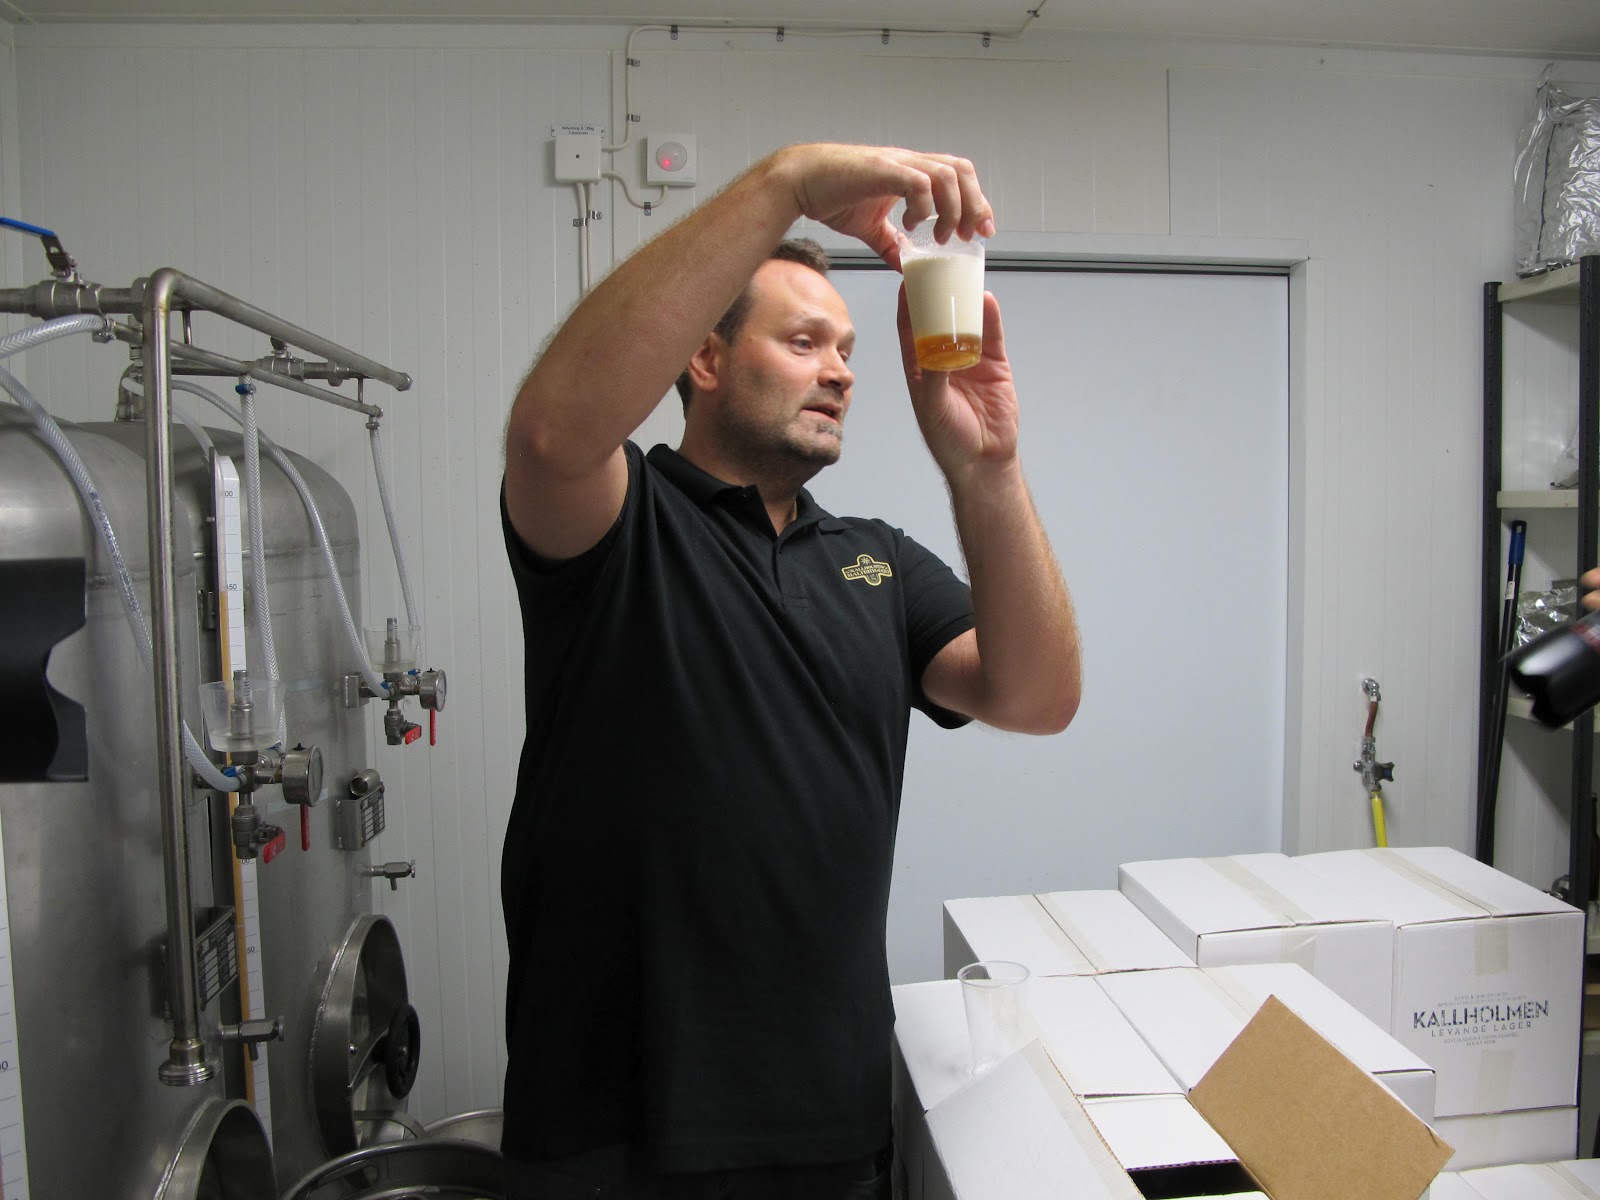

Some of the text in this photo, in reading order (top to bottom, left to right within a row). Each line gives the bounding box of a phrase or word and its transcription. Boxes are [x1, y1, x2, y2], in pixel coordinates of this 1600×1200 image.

[1413, 1000, 1549, 1029] KALLHOLMEN
[1431, 1021, 1532, 1037] LEVANDE LAGER
